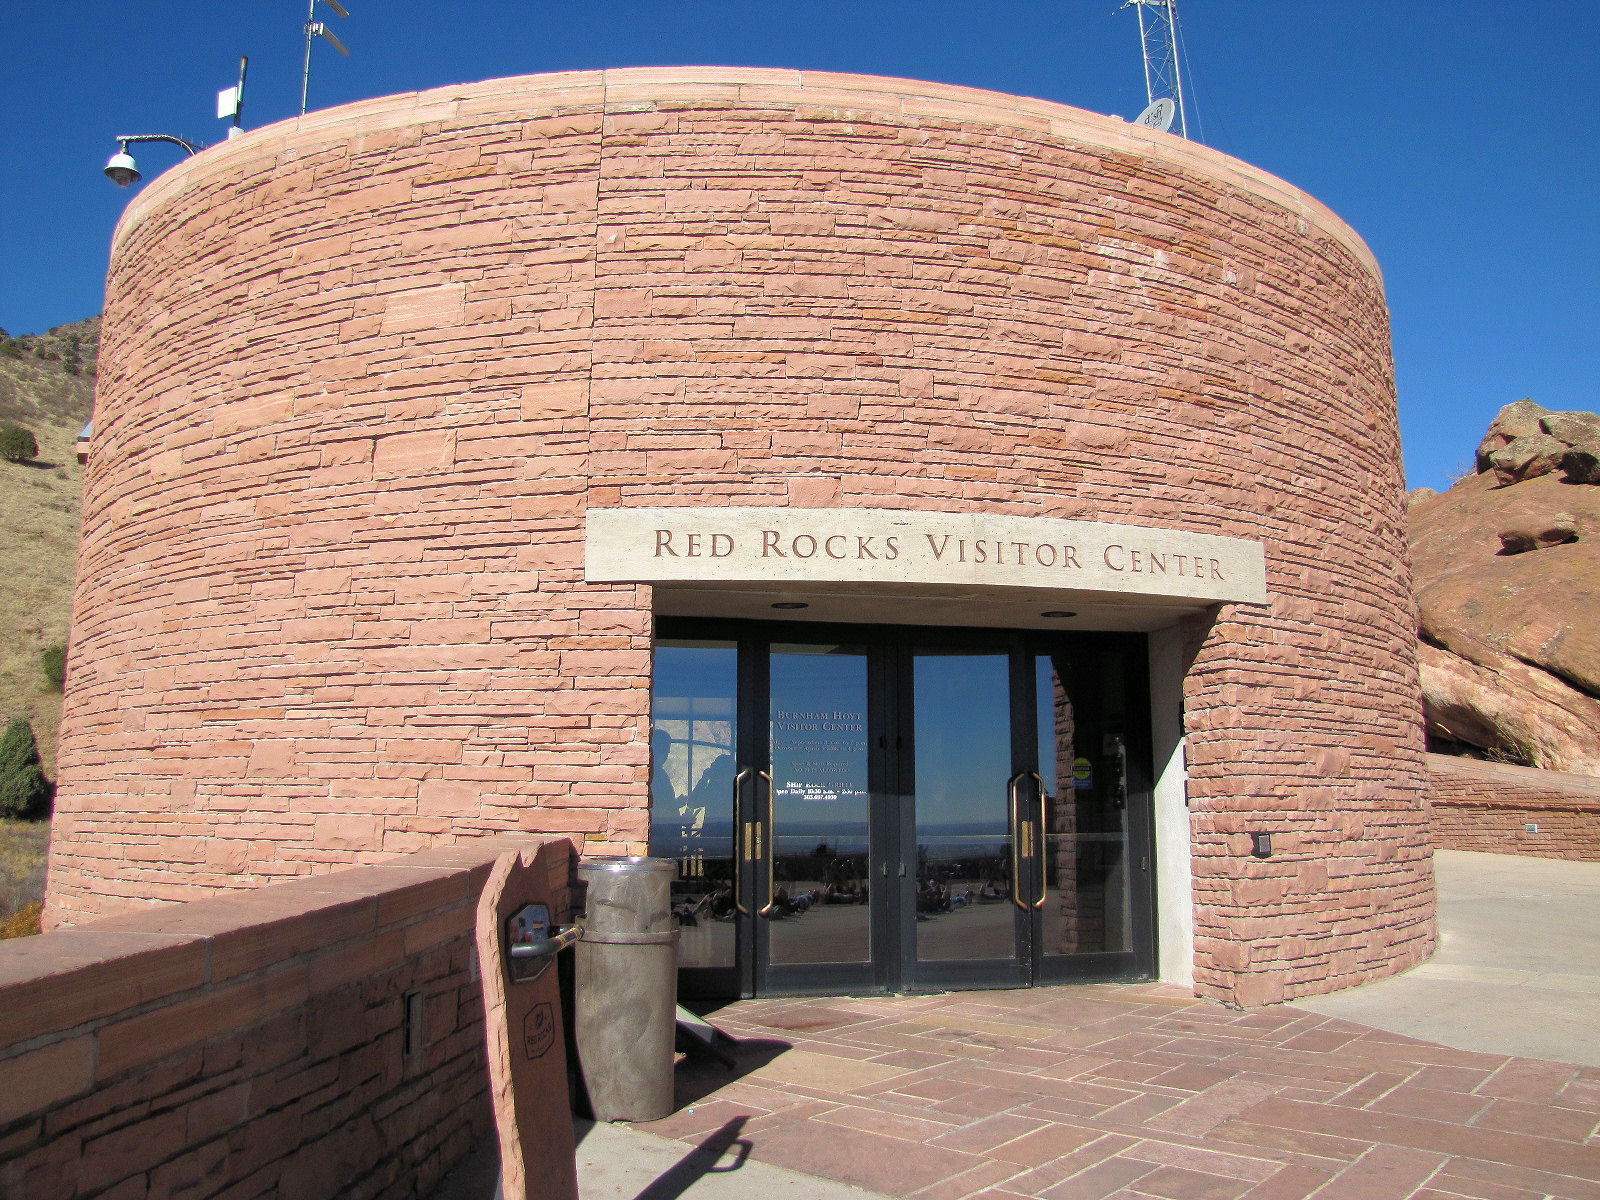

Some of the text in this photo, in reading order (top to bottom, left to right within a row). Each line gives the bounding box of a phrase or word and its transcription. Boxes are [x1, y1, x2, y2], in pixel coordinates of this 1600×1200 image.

[653, 529, 1225, 581] RED ROCKS VISITOR CENTER
[777, 721, 862, 731] VISITOR CENTER
[790, 788, 806, 796] Daily
